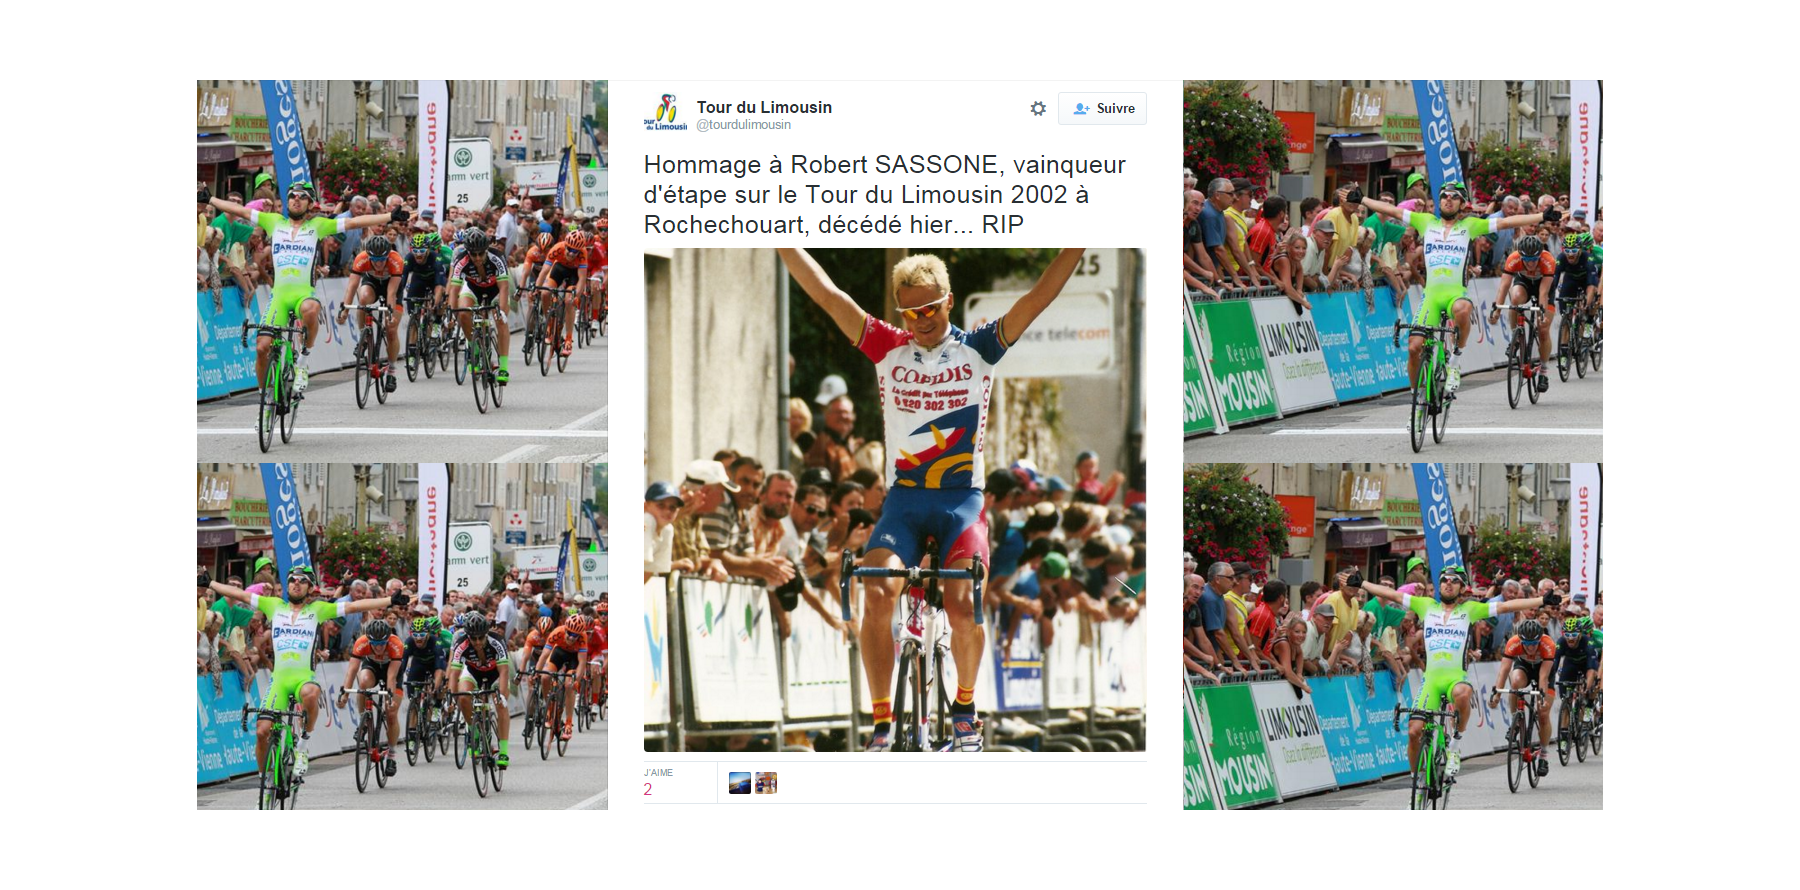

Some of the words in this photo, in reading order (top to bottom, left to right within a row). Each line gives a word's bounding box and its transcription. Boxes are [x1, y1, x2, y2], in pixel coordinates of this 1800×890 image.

[697, 101, 732, 114] Tour
[737, 101, 756, 114] du
[761, 101, 832, 114] Limousin
[1097, 101, 1136, 114] Suivre
[696, 119, 791, 132] @tourdulimousin
[645, 155, 761, 178] Hommage
[769, 154, 782, 173] à
[792, 155, 868, 173] Robert
[875, 155, 1004, 177] SASSONE,
[1013, 155, 1126, 178] vainqueur
[470, 171, 489, 181] vert
[457, 193, 469, 204] 25
[644, 185, 726, 208] d'étape
[735, 190, 770, 203] sur
[779, 185, 797, 203] le
[805, 185, 858, 203] Tour
[866, 185, 892, 203] du
[902, 185, 1002, 203] Limousin
[1011, 185, 1067, 203] 2002
[1076, 184, 1089, 203] à
[645, 215, 809, 237] Rochechouart,
[819, 215, 901, 233] décédé
[911, 215, 972, 233] hier...
[983, 215, 1023, 233] RIP
[273, 243, 315, 255] BARDIANI
[1425, 243, 1467, 255] BARDIANI
[1047, 326, 1110, 342] telecom
[1260, 320, 1321, 358] LIMOUSIN
[1226, 342, 1262, 366] Région
[924, 400, 944, 411] 302
[948, 397, 968, 409] 302
[470, 555, 489, 565] vert
[457, 577, 469, 588] 25
[273, 627, 315, 639] BARDIANI
[1425, 627, 1467, 639] BARDIANI
[1260, 704, 1321, 742] LIMOUSIN
[1226, 726, 1262, 750] Région
[644, 768, 673, 777] J'AIME
[644, 783, 652, 795] 2
